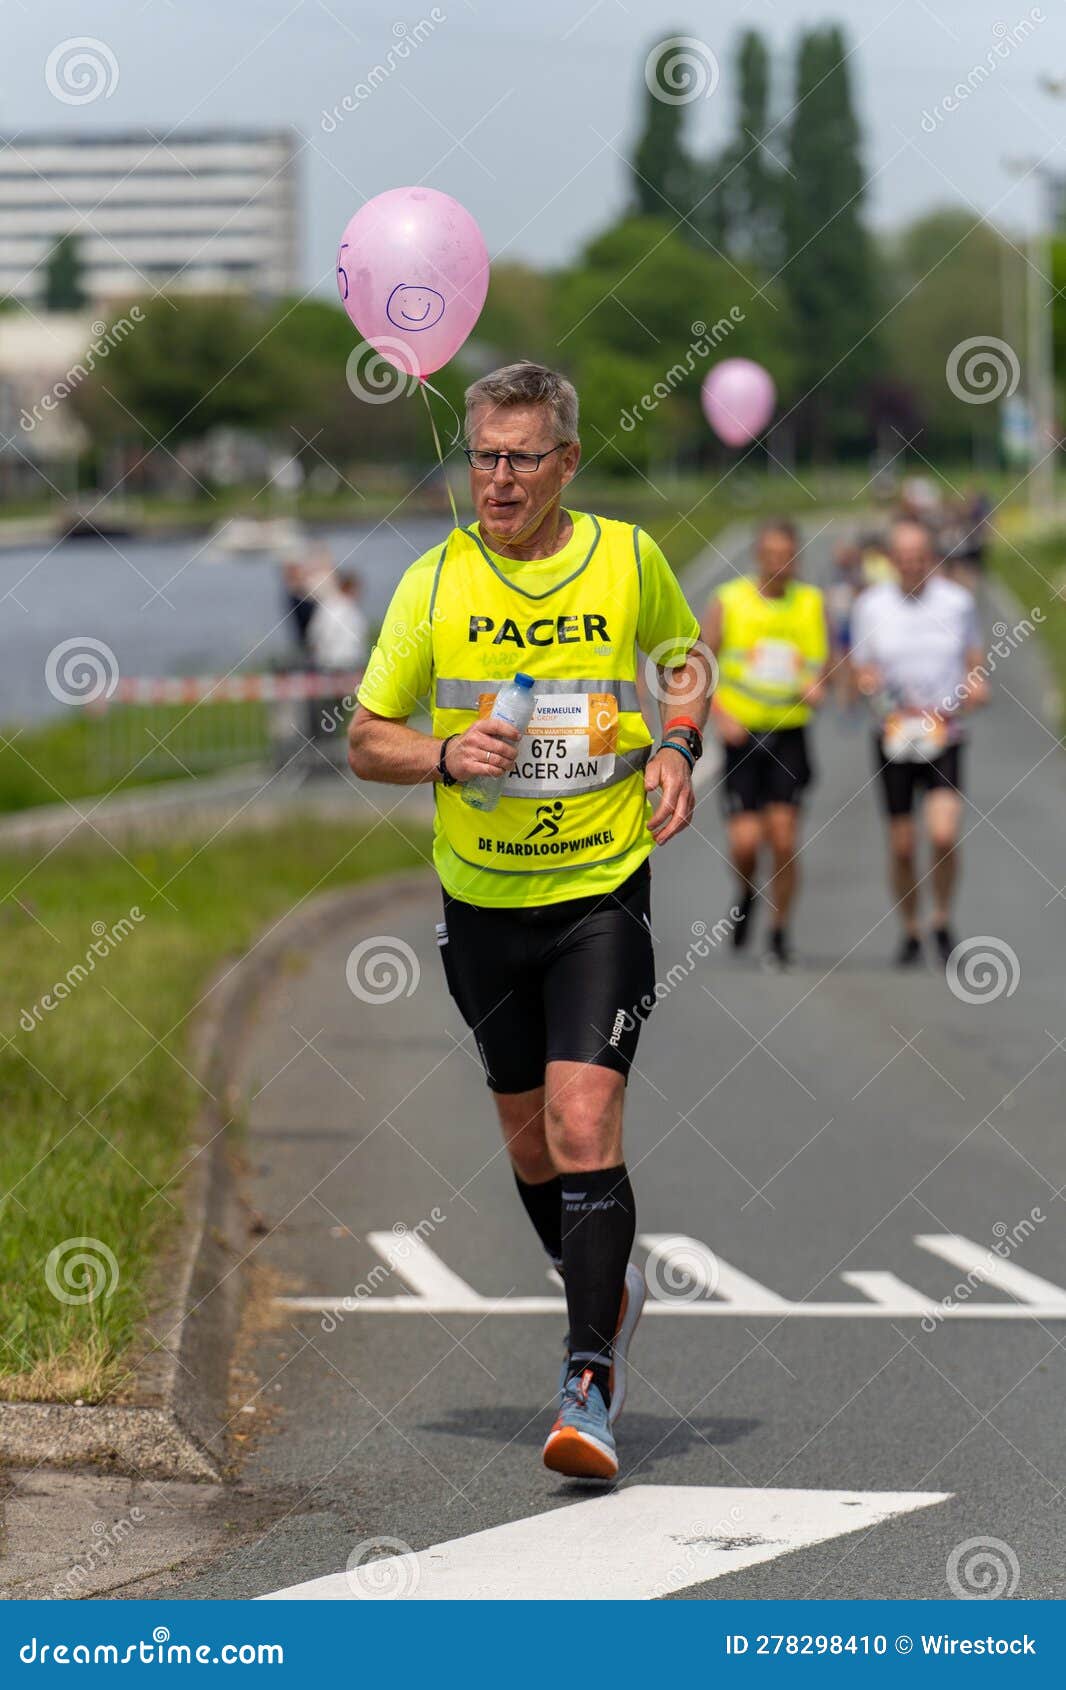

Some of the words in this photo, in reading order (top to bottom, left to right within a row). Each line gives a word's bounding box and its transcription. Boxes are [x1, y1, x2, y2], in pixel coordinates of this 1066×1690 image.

[468, 614, 612, 648] PACER
[536, 706, 582, 715] VERMEULEN
[531, 739, 567, 759] 675
[508, 762, 559, 779] ACER
[564, 761, 598, 779] JAN
[478, 836, 492, 852] DE
[496, 829, 615, 856] HARDLOOPWINKEL
[609, 1008, 626, 1047] FUSION
